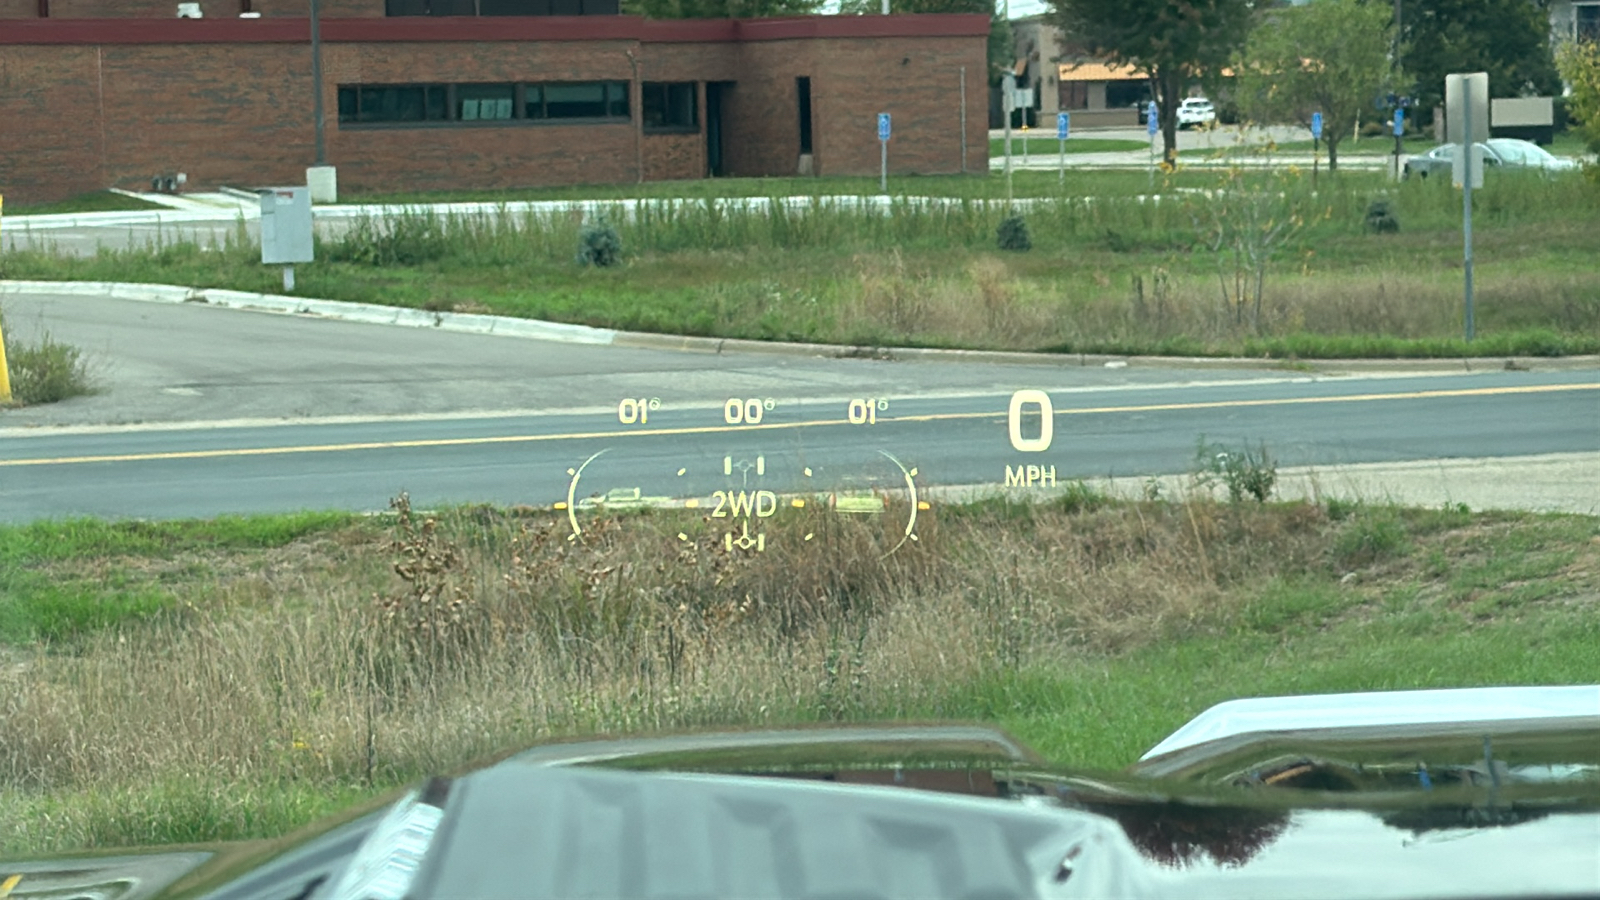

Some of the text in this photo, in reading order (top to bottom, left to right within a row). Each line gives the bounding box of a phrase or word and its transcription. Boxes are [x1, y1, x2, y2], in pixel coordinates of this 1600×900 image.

[1008, 388, 1054, 452] 0
[1005, 465, 1057, 488] MPH
[711, 490, 777, 518] 2WD
